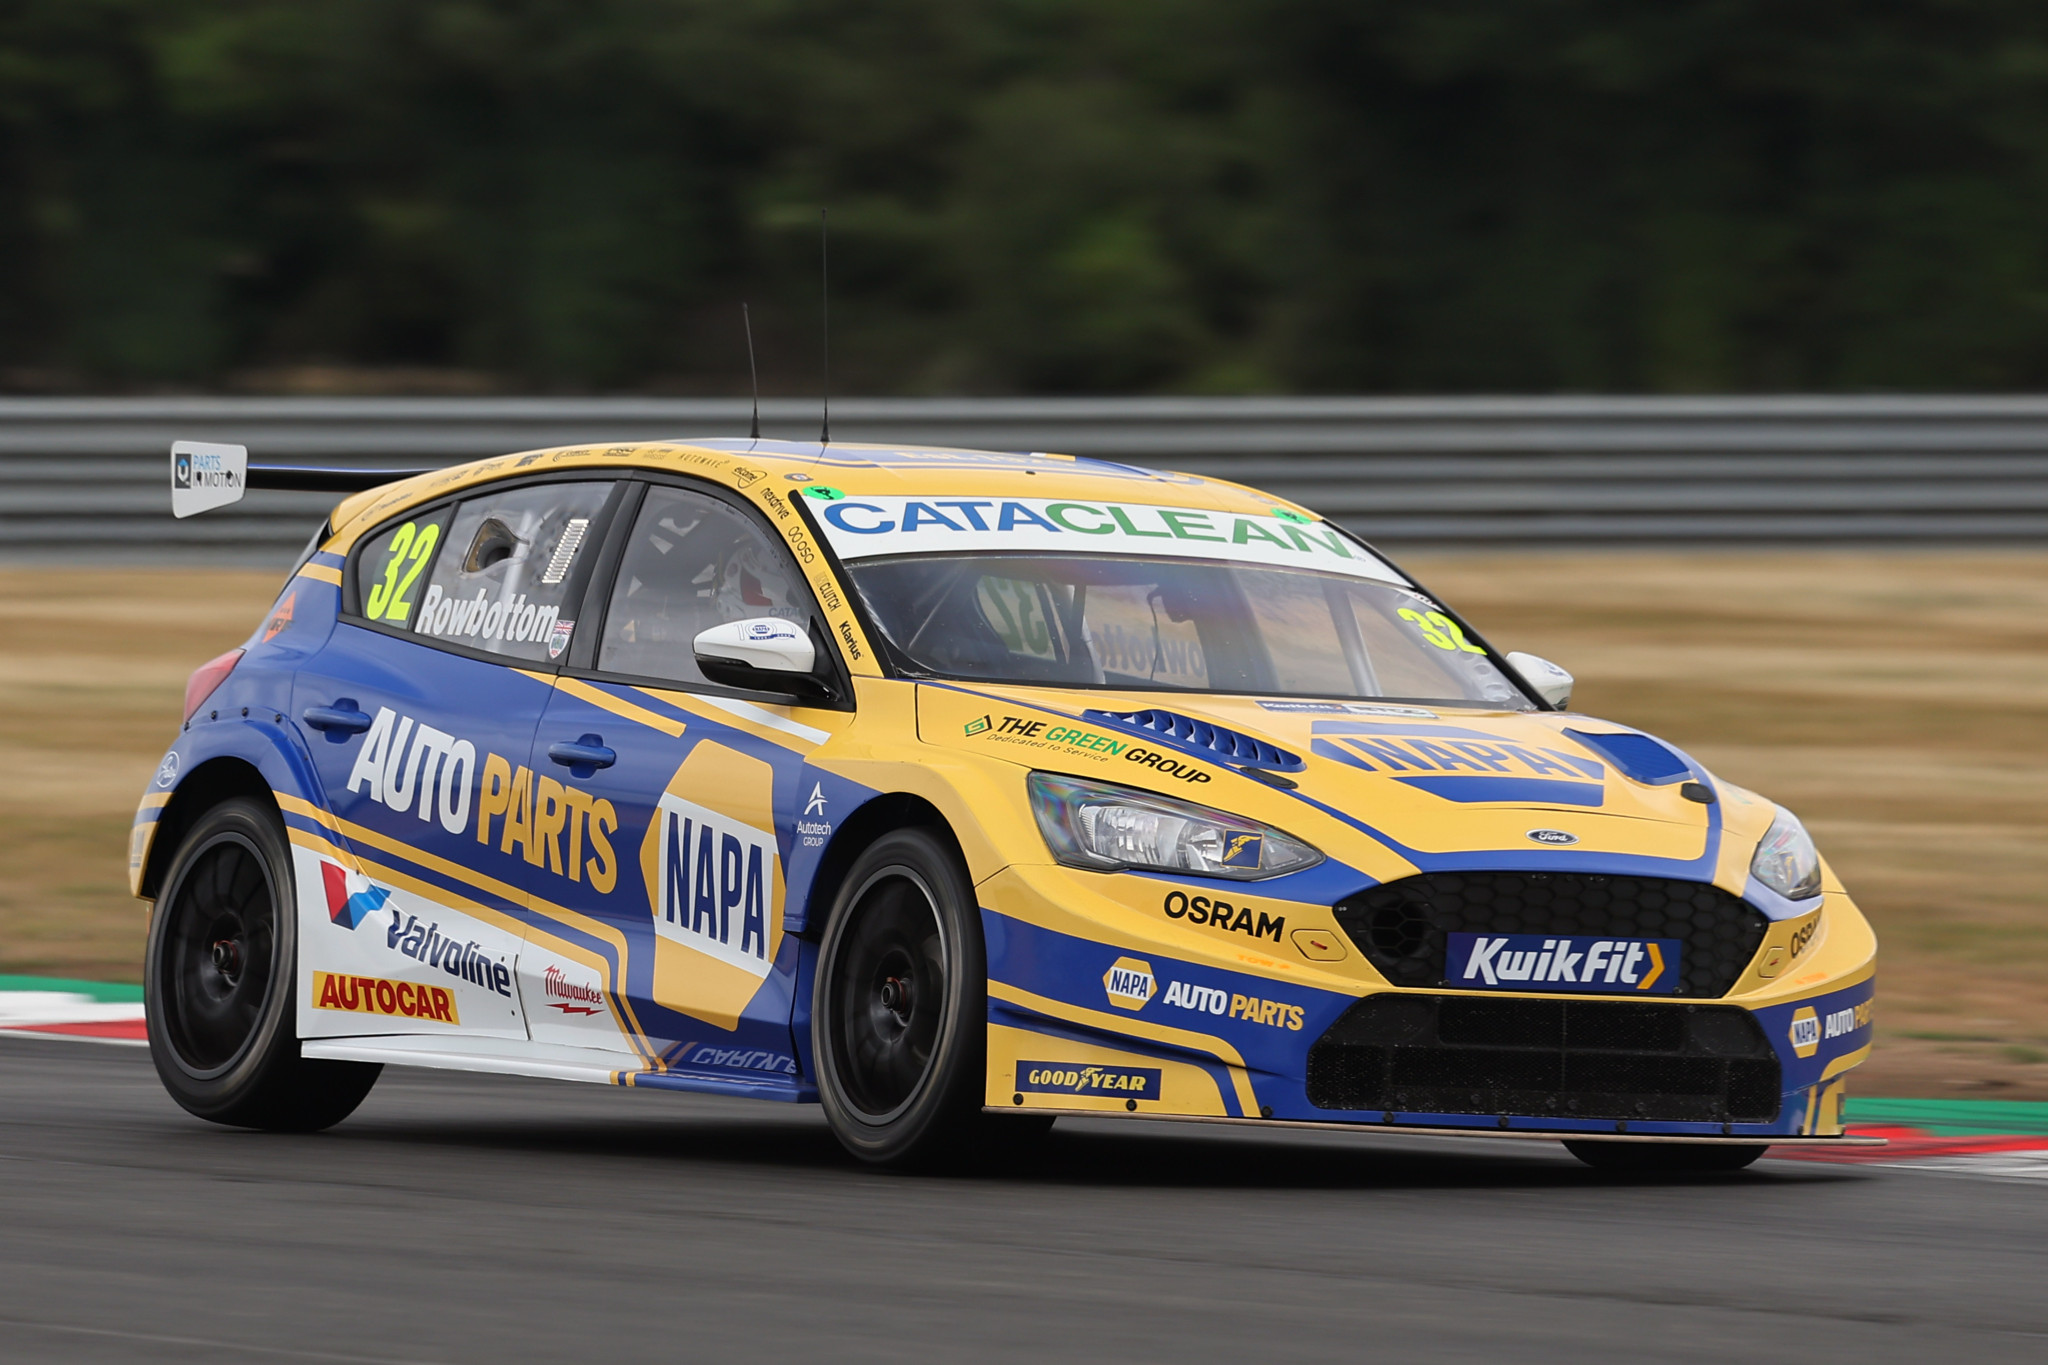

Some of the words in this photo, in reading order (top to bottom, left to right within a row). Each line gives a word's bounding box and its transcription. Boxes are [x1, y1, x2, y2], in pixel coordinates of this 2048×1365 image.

[193, 455, 221, 470] PARTS
[204, 470, 242, 487] MOTION
[824, 501, 1355, 559] CATACLEAN
[366, 521, 440, 621] 32
[415, 584, 560, 643] Rowbottom
[1397, 608, 1488, 656] 32
[839, 620, 861, 661] Klarius
[987, 733, 1047, 749] Dedicated
[1050, 744, 1061, 752] to
[1063, 747, 1109, 763] Service
[997, 716, 1047, 738] THE
[1046, 727, 1128, 756] GREEN
[1125, 748, 1212, 785] GROUP
[1341, 737, 1584, 779] NAPA
[347, 706, 476, 835] AUTO
[477, 752, 618, 895] PARTS
[797, 820, 831, 836] Autotech
[803, 836, 824, 848] GROUP
[667, 811, 766, 961] NAPA
[1163, 890, 1286, 943] OSRAM
[387, 909, 512, 998] Valvoline
[319, 974, 454, 1023] AUTOCAR
[543, 964, 604, 1004] Milwaukee
[1110, 969, 1150, 998] NAPA
[1163, 980, 1228, 1015] AUTO
[1229, 994, 1306, 1031] PARTS
[1825, 1007, 1855, 1039] AUTO
